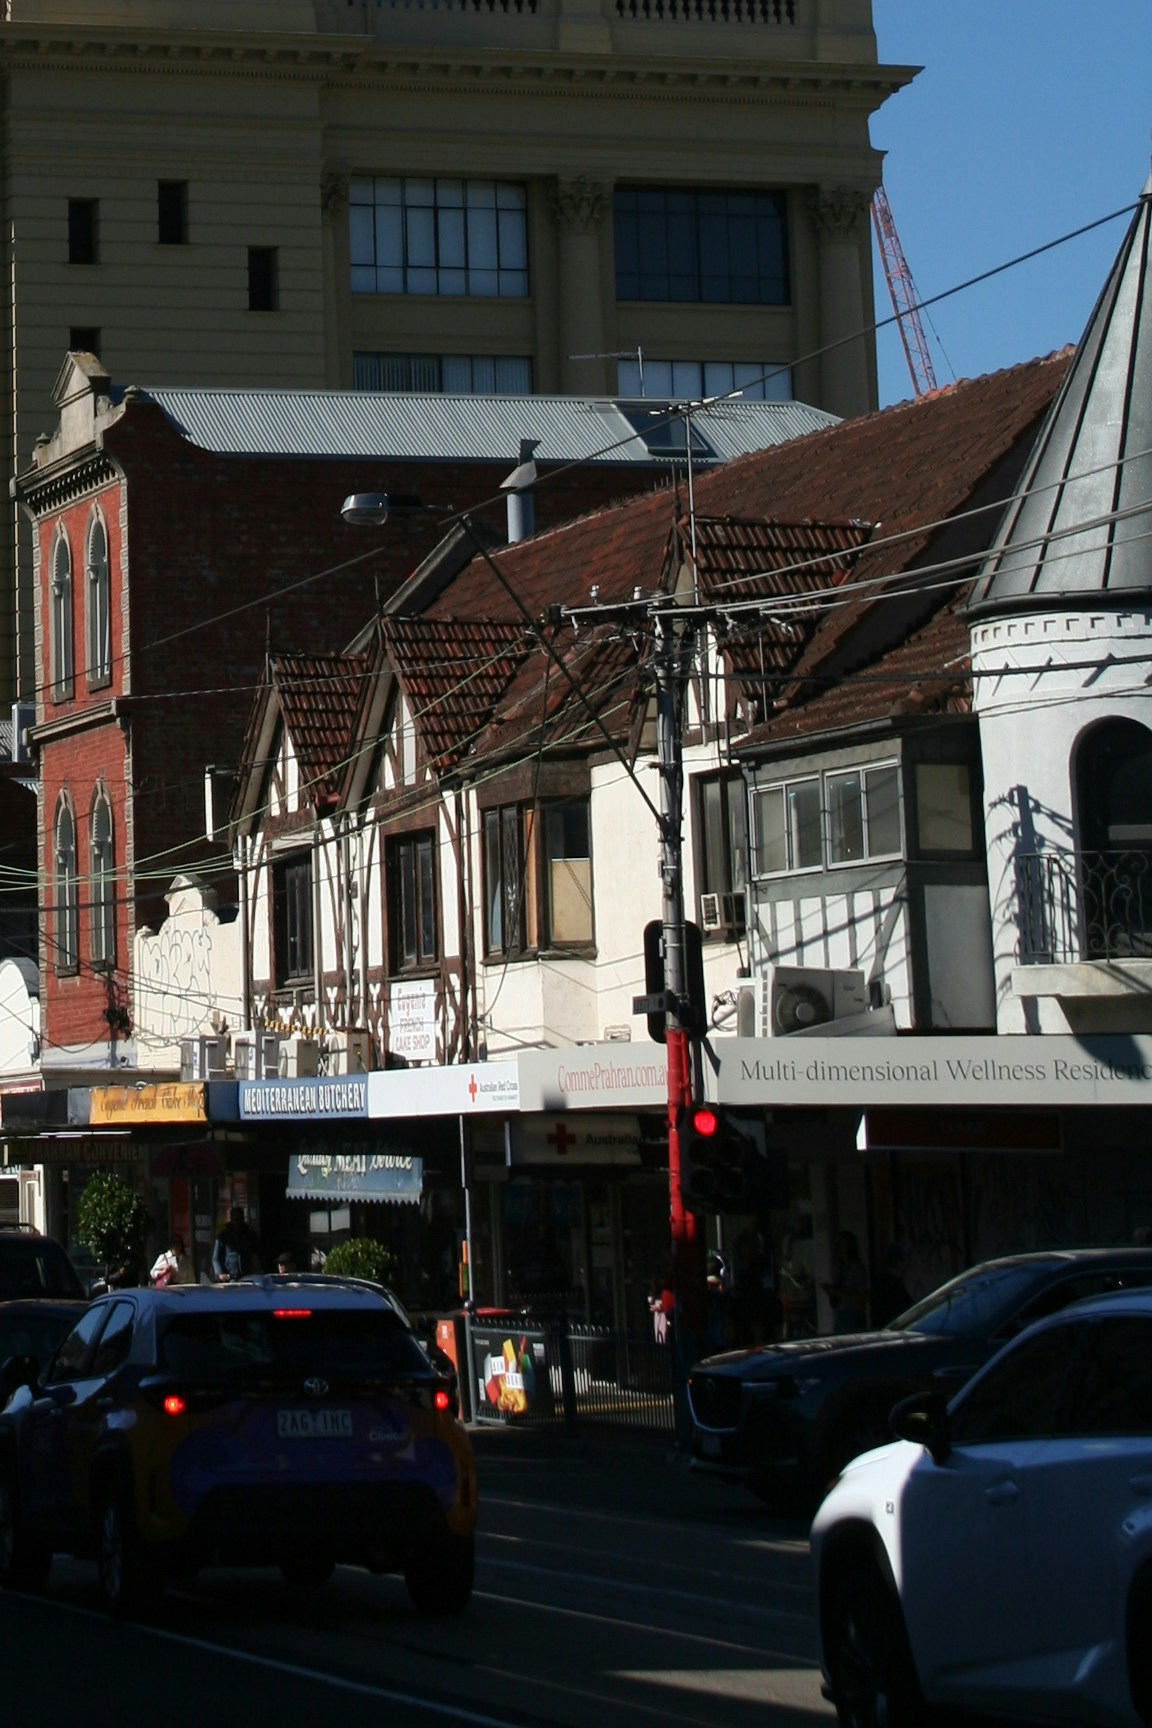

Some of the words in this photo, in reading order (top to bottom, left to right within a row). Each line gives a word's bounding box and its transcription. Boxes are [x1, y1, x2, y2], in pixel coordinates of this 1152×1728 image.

[412, 1034, 430, 1050] SHOP
[741, 1060, 938, 1081] Multi-dimensional
[946, 1060, 1046, 1080] Wellness
[244, 1086, 316, 1114] MEDITERRANEAN
[318, 1083, 366, 1112] BUTCHERY
